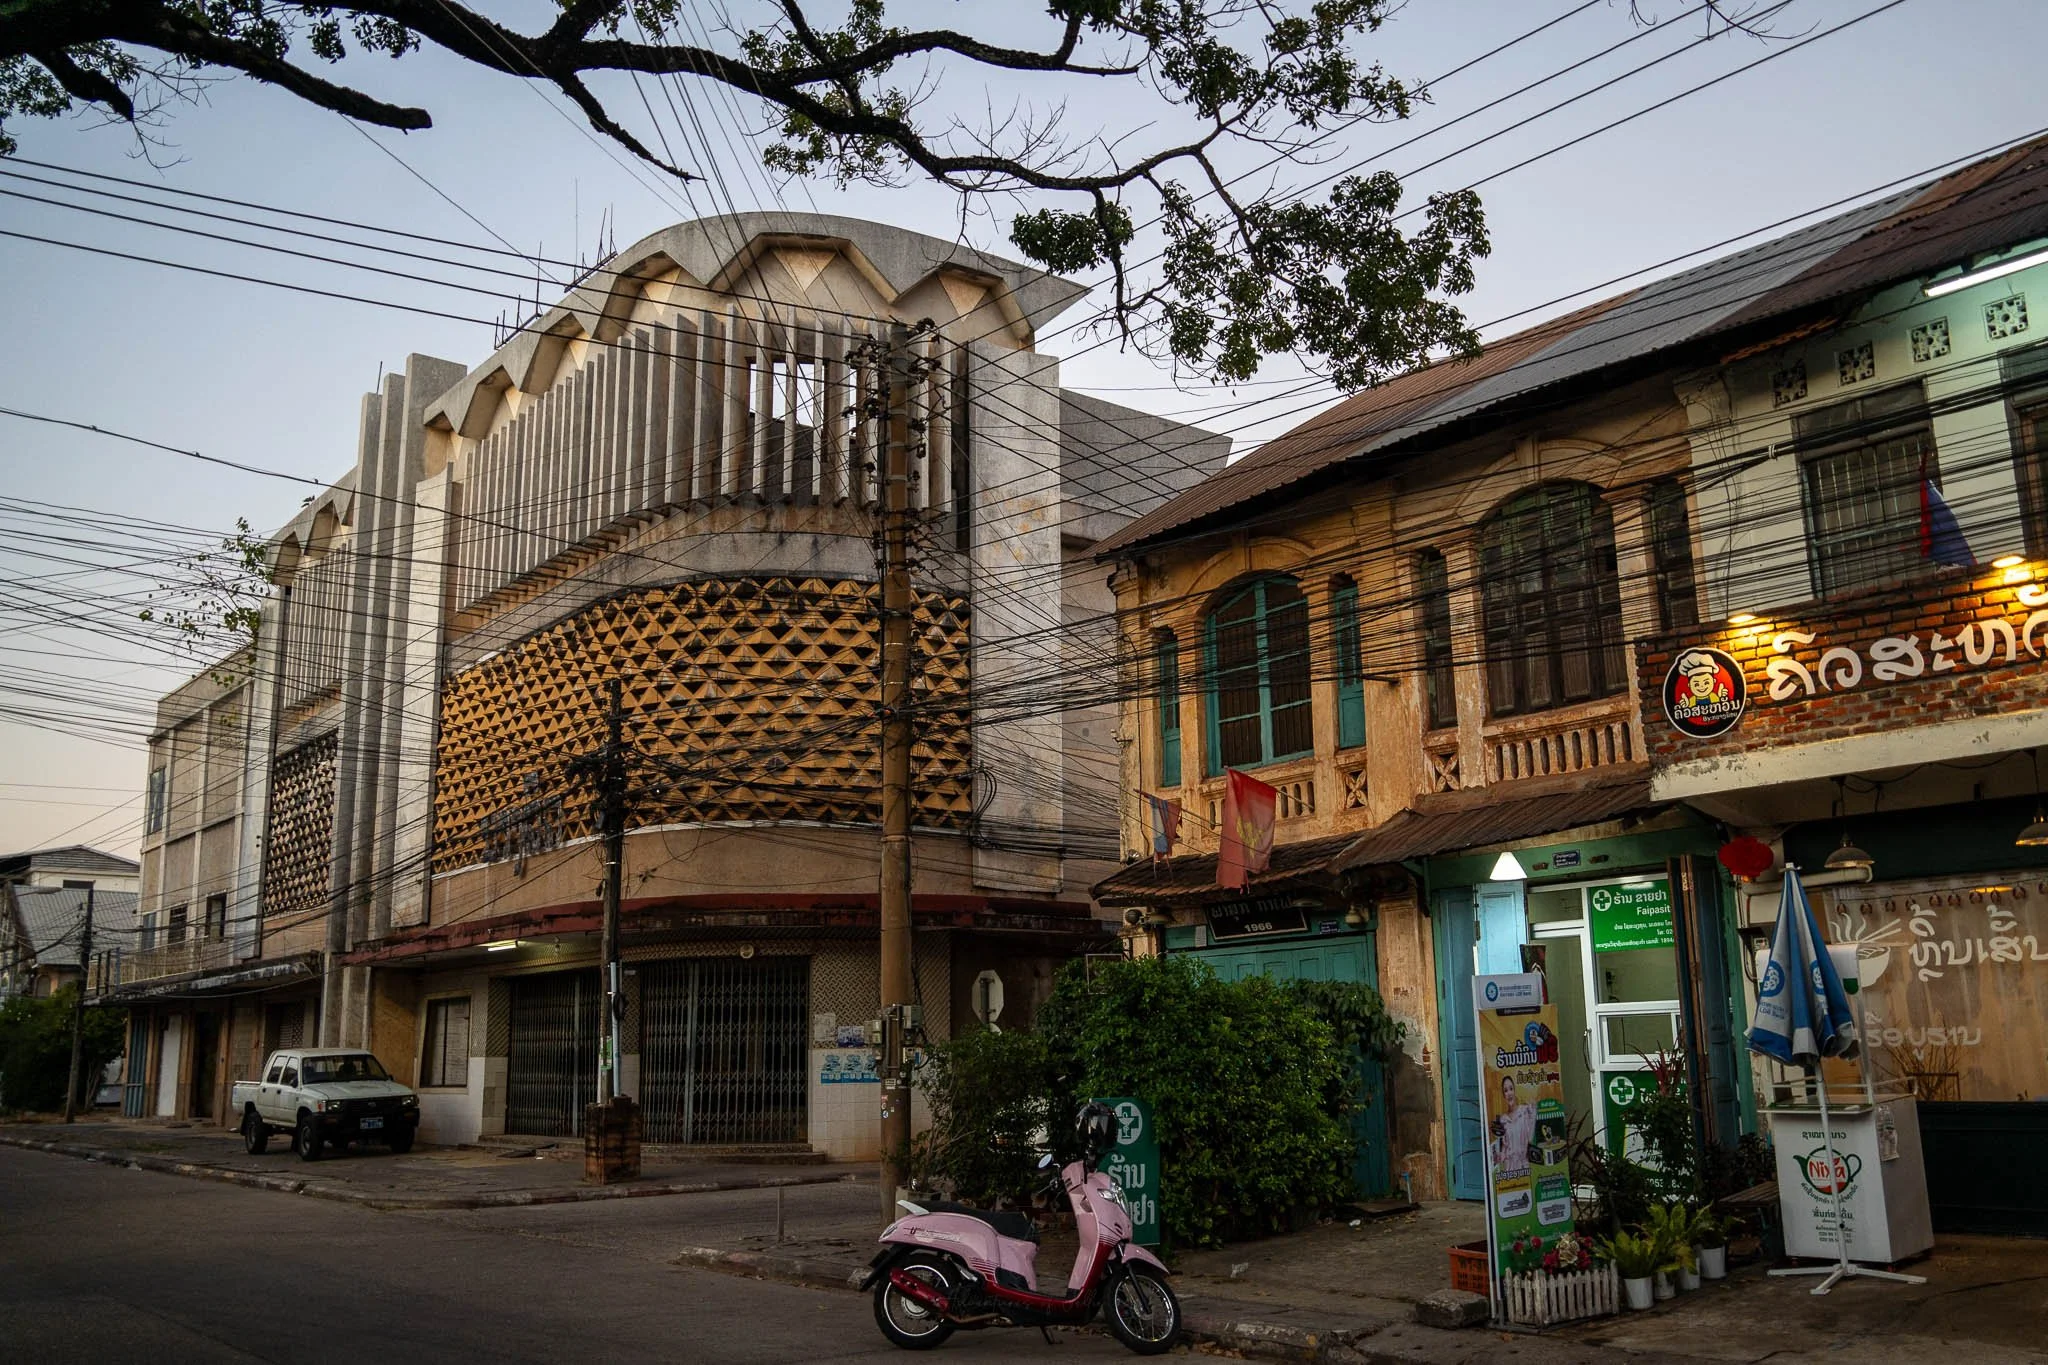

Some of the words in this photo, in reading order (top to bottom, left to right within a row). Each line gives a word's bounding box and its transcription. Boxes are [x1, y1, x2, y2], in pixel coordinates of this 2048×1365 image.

[1613, 892, 1633, 905] ຮ້ານ
[1635, 890, 1667, 903] ຂາຍຢາ
[1244, 922, 1273, 933] 1966
